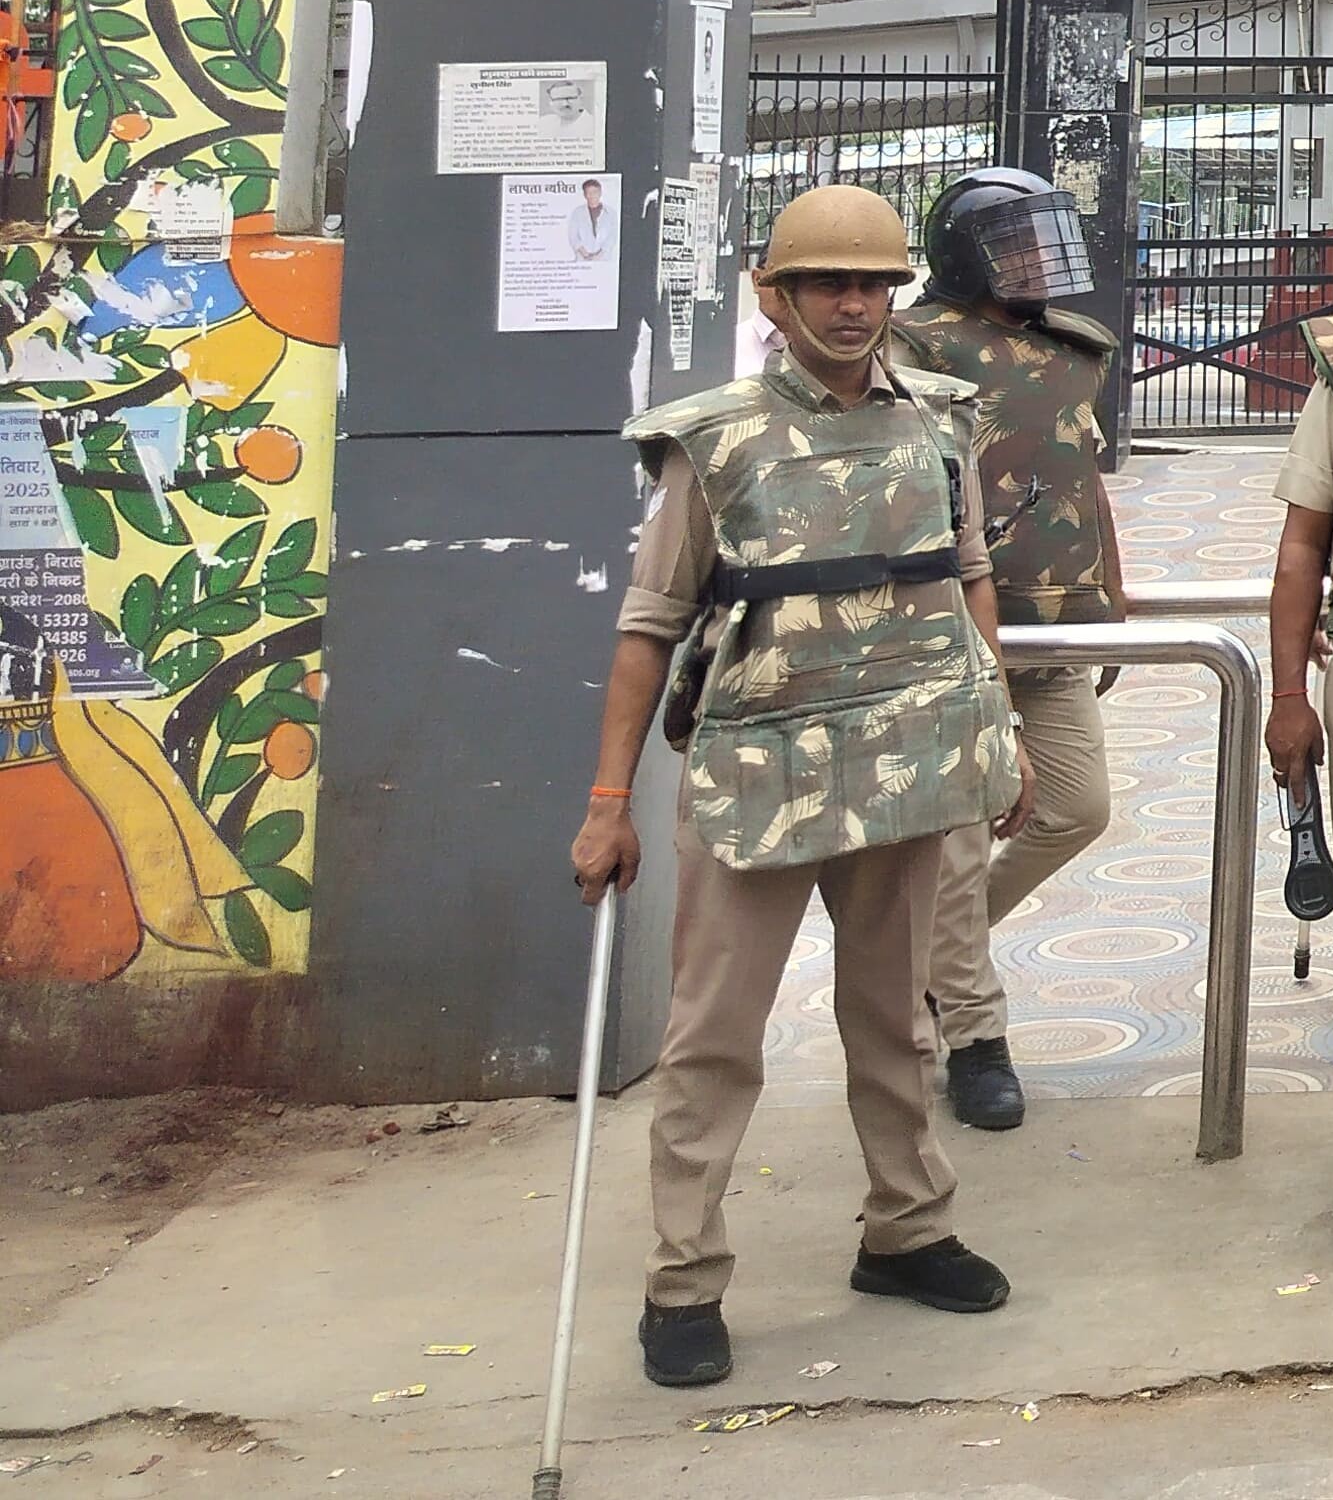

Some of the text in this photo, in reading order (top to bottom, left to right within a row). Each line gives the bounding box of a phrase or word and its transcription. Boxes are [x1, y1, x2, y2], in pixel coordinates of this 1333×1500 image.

[508, 184, 542, 194] लापता
[0, 456, 46, 476] तिवार,
[4, 483, 50, 498] 2025
[23, 572, 39, 587] के
[43, 612, 89, 627] 53373
[53, 648, 87, 662] 926
